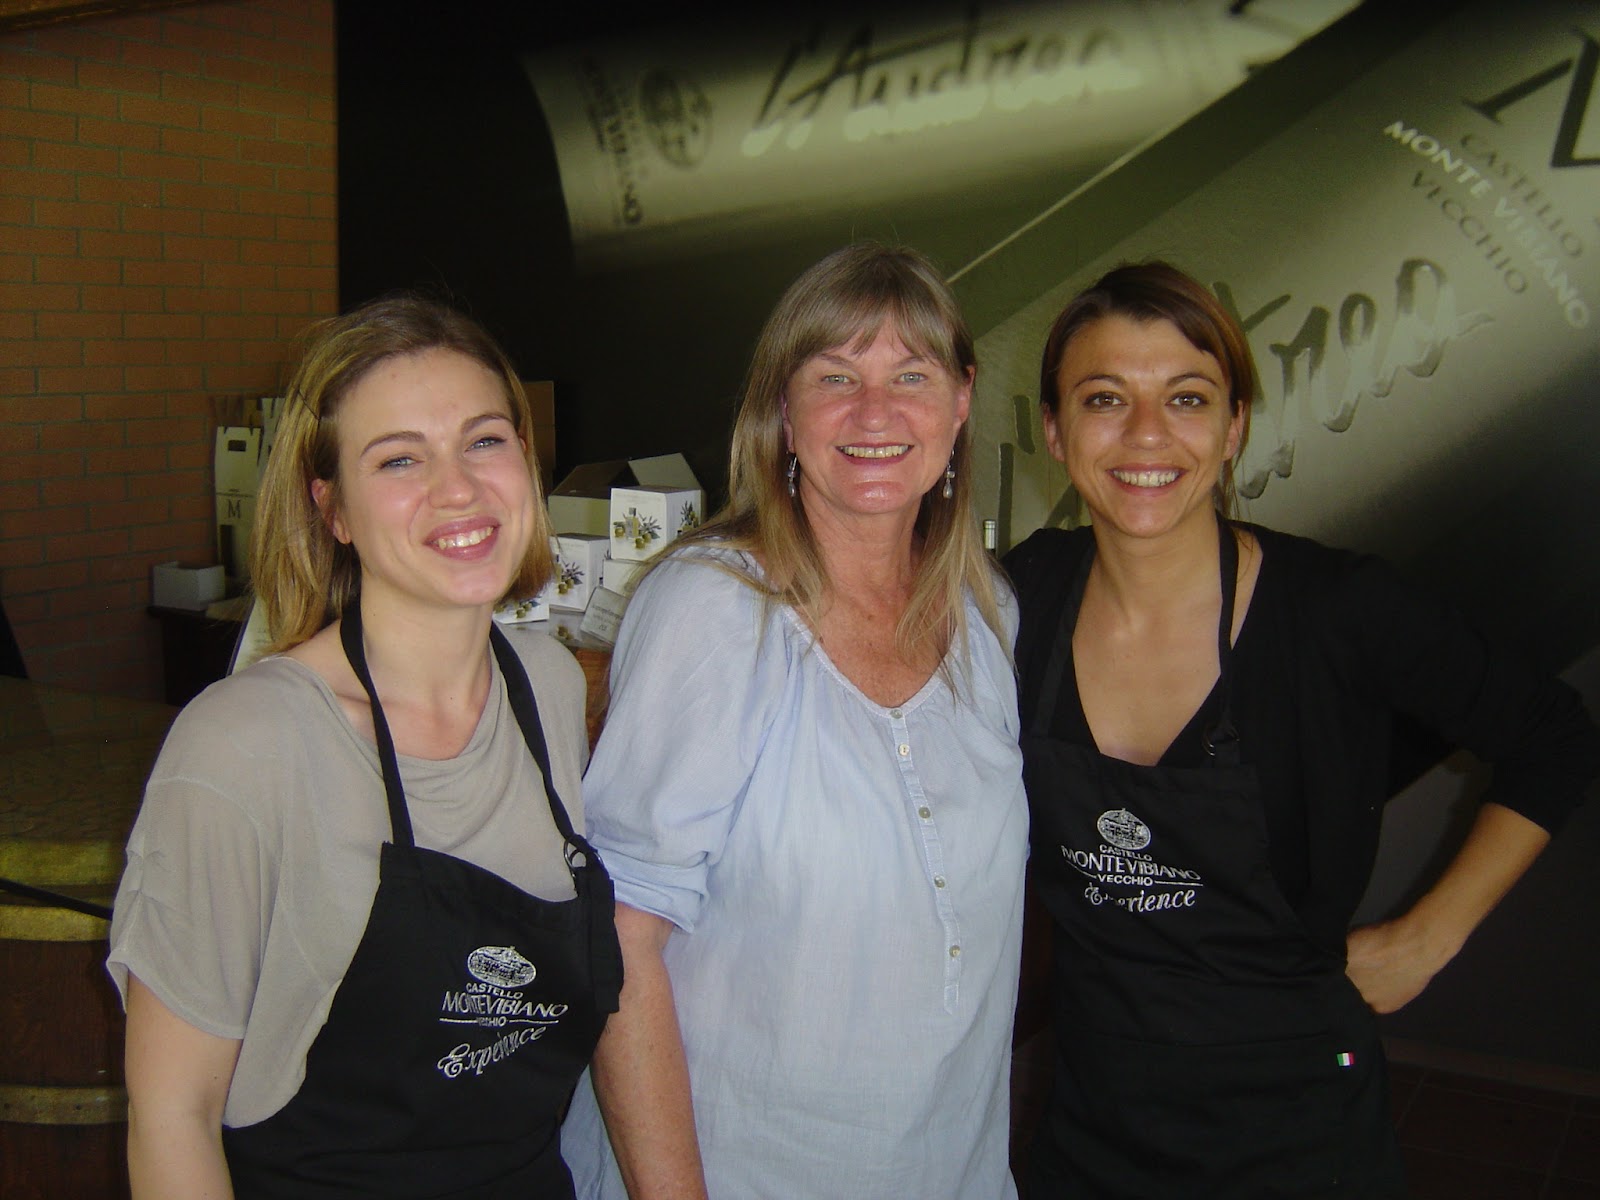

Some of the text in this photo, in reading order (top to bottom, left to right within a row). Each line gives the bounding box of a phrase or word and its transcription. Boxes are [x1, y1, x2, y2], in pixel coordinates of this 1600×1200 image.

[1383, 120, 1492, 198] MONTE
[1460, 132, 1583, 257] CASTELLO
[1412, 169, 1528, 294] VECCHIO
[1061, 845, 1202, 881] MONTEVIBIANO
[1099, 844, 1153, 862] CASTELLO
[1098, 874, 1154, 887] VECCHIO
[441, 991, 569, 1018] MONTEVIBIANO
[466, 982, 524, 1000] CASTELLO
